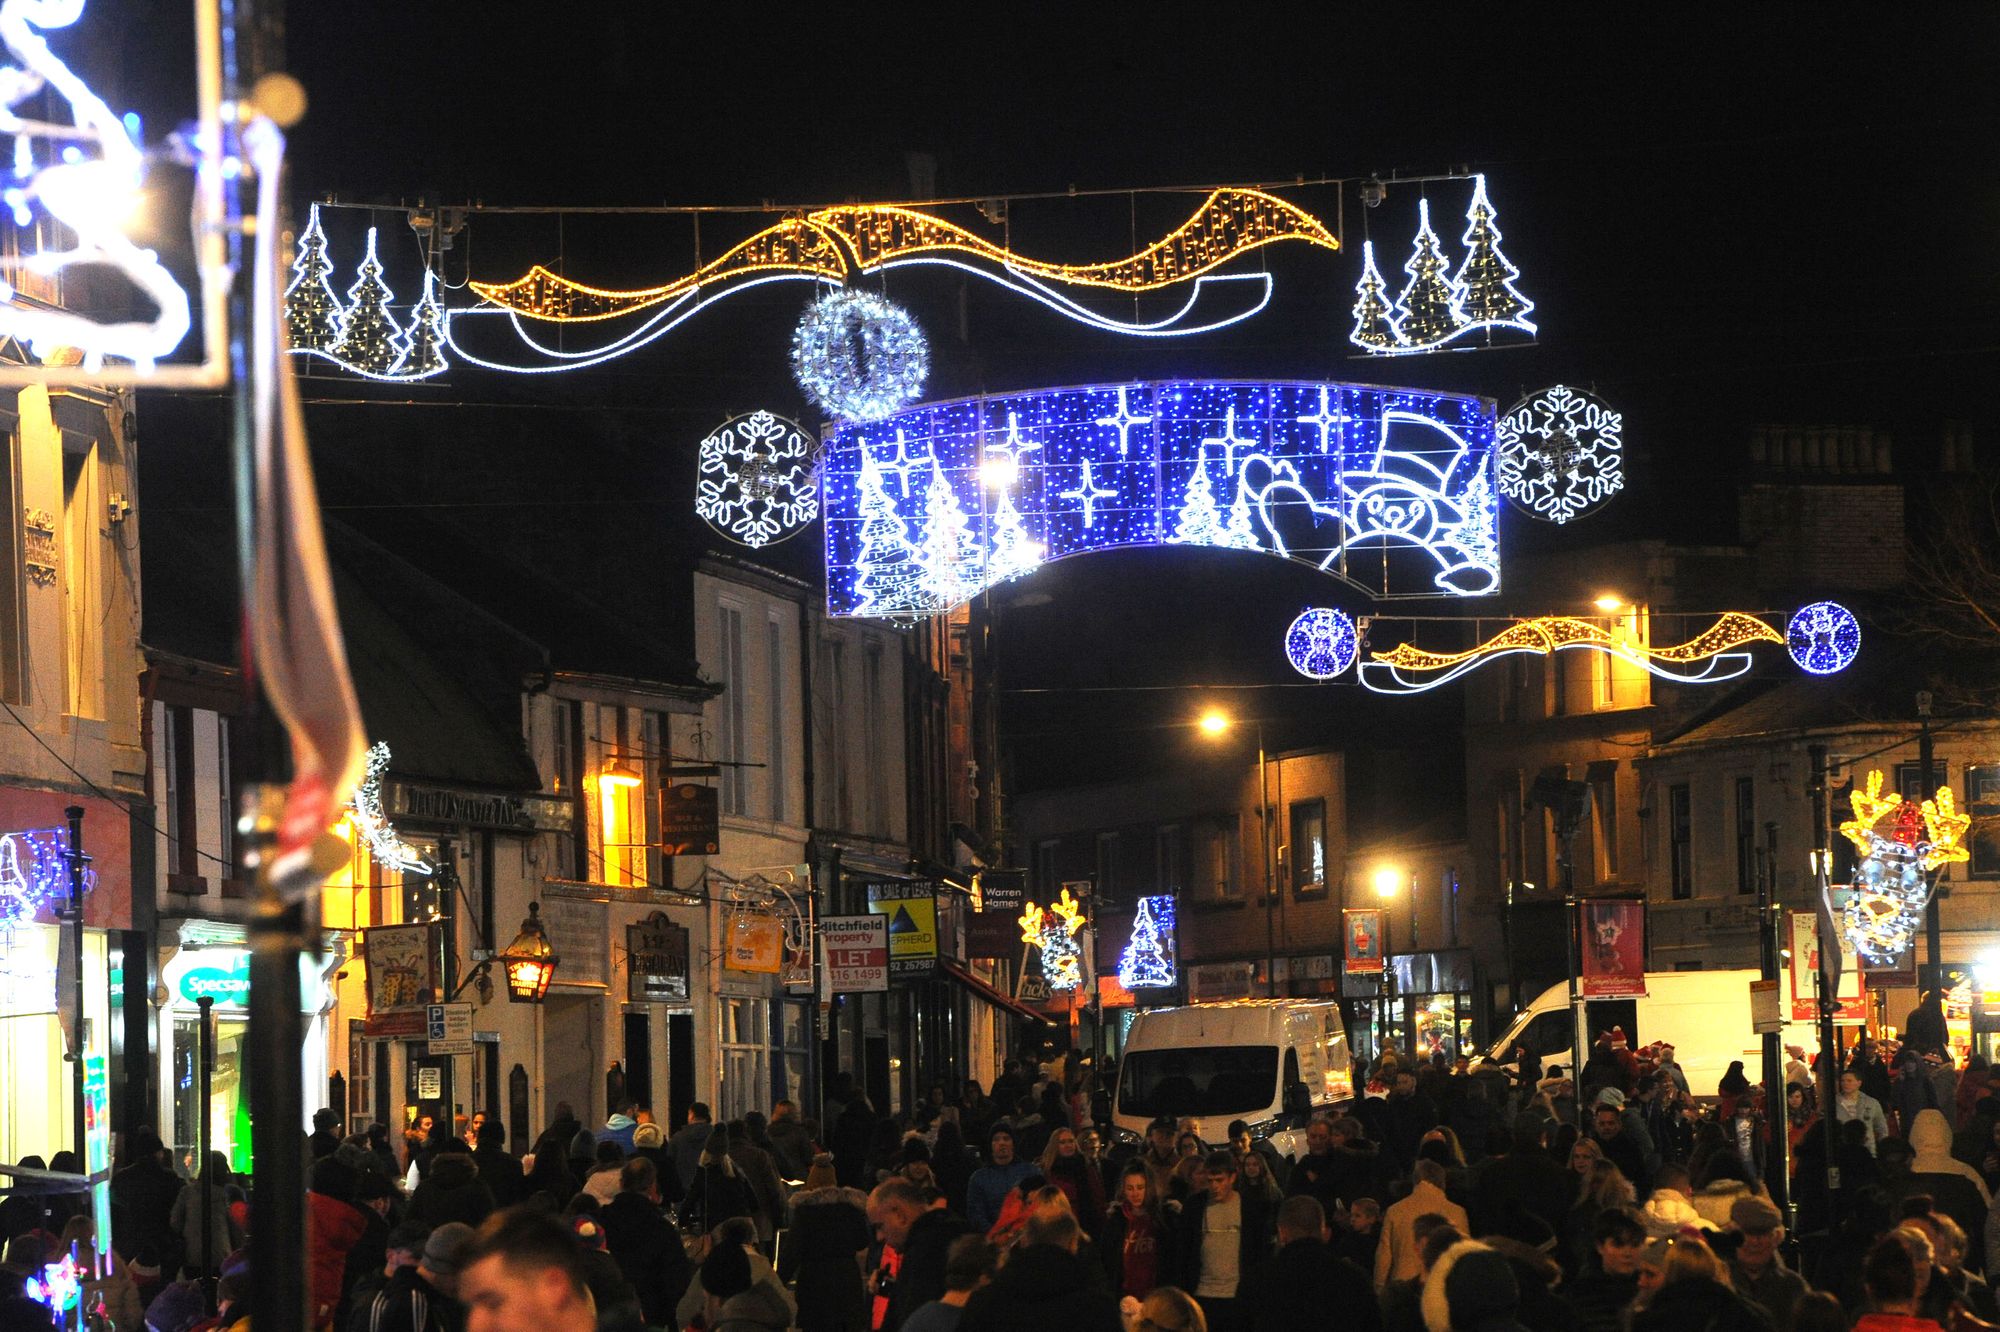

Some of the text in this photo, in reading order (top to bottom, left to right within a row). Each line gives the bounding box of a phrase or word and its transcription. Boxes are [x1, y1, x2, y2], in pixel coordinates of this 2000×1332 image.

[883, 883, 900, 899] SALE
[912, 881, 932, 898] LEASE
[985, 887, 1022, 897] Warren
[985, 898, 1019, 908] James
[820, 919, 882, 932] ditchfield
[890, 933, 932, 945] EPHERD
[837, 950, 872, 966] LET
[890, 961, 901, 971] 92
[854, 968, 882, 979] 1499
[189, 976, 251, 995] Specsav
[517, 988, 532, 997] INN
[432, 1008, 442, 1021] P
